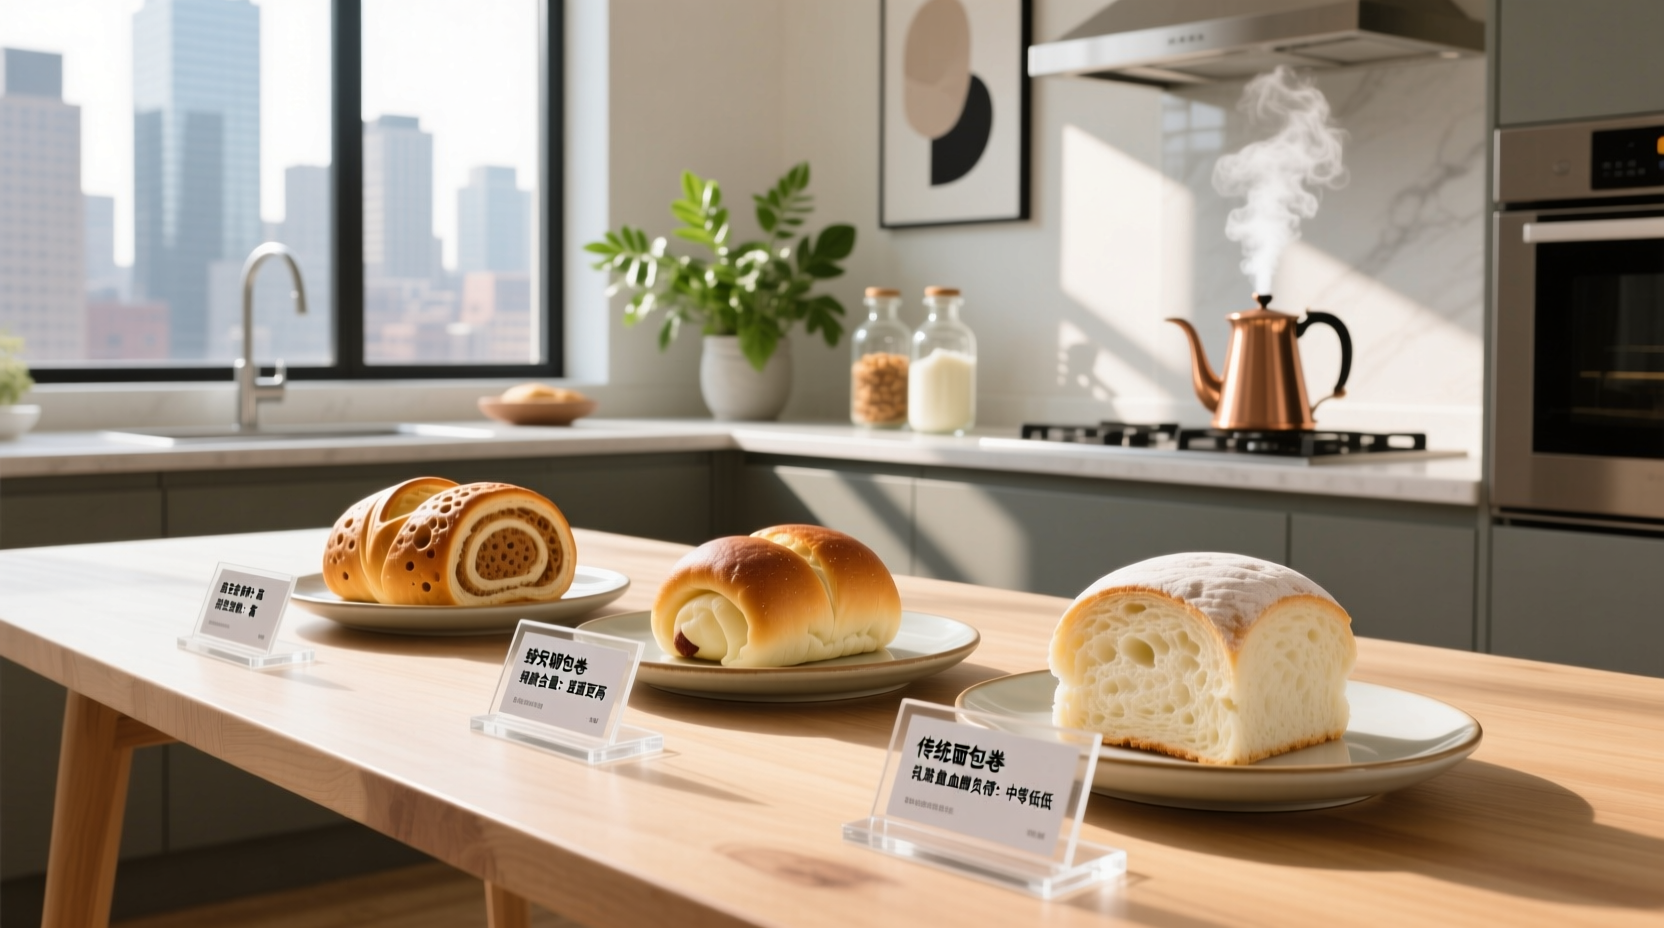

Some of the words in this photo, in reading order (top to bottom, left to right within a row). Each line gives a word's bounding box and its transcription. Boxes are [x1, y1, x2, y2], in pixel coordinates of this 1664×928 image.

[917, 736, 1006, 773] 传统面包卷
